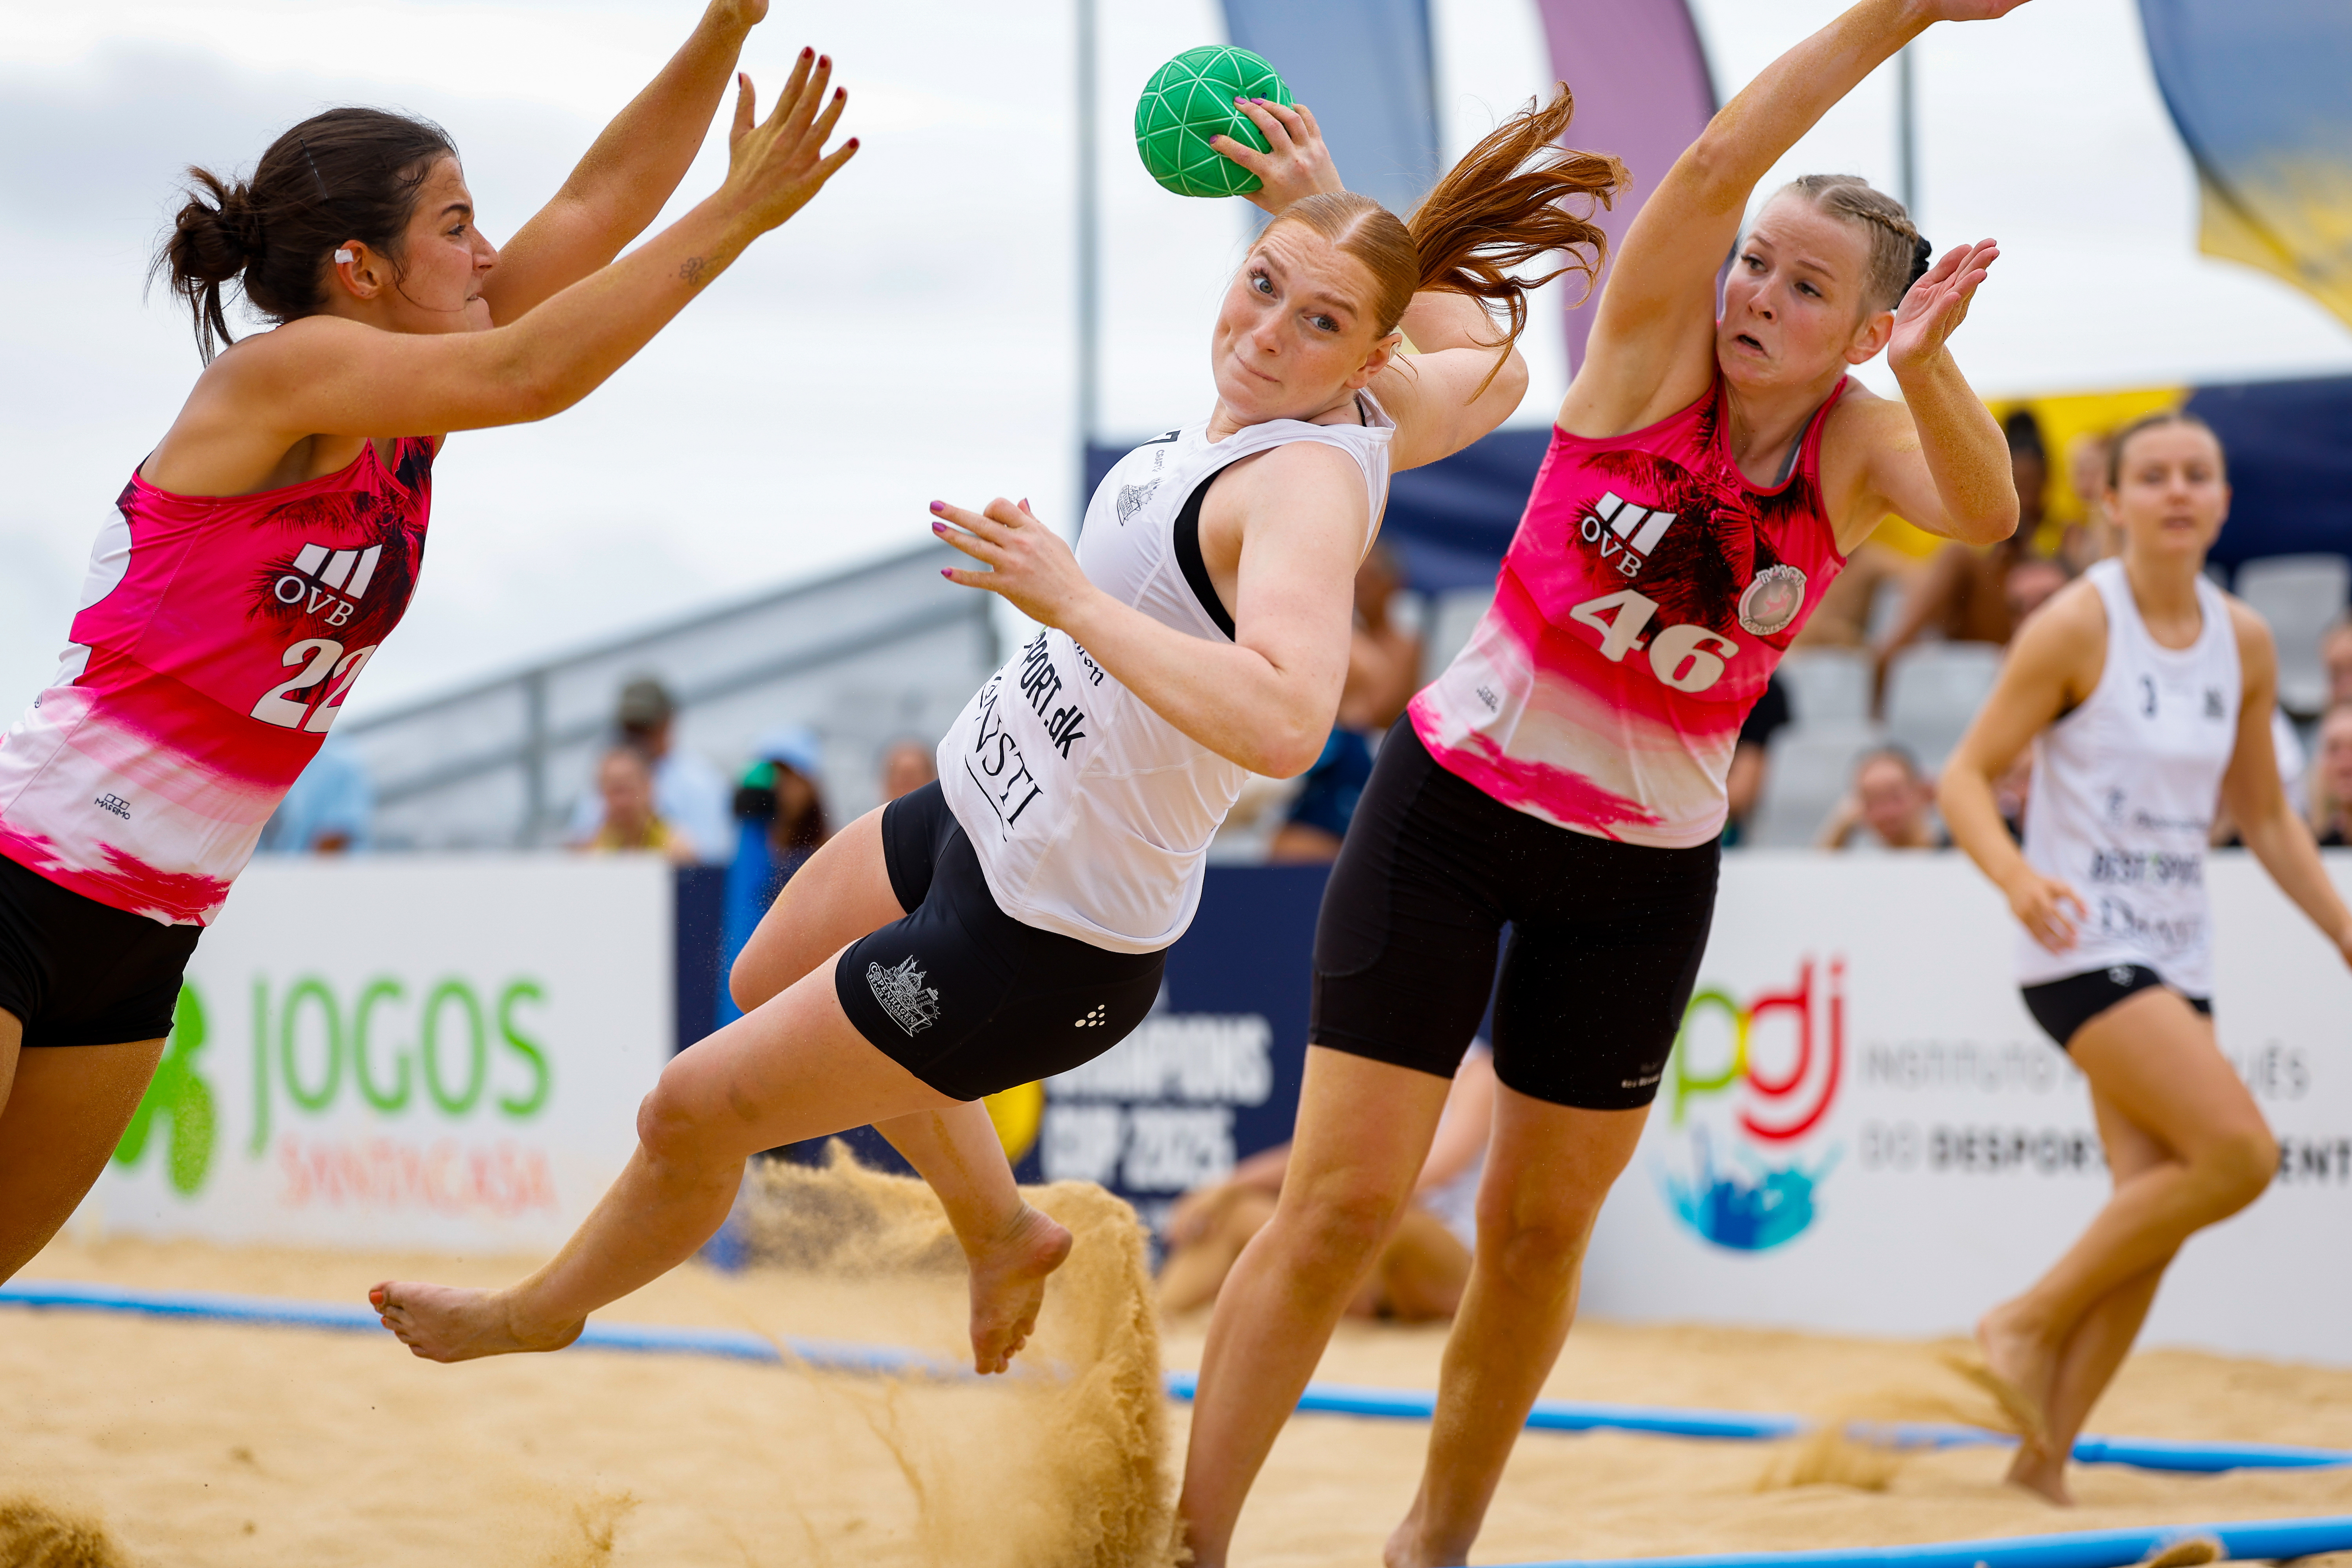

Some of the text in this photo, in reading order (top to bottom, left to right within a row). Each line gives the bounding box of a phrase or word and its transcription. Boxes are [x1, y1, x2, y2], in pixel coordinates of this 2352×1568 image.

[1153, 450, 1165, 467] CRAFT
[1581, 515, 1642, 577] OVB
[275, 576, 354, 626] OVB
[1569, 588, 1740, 693] 46
[249, 638, 377, 733] 22
[868, 974, 912, 1025] BEACH HANDBALL
[871, 965, 916, 1023] COPENHAGEN
[250, 975, 553, 1154] JOGOS
